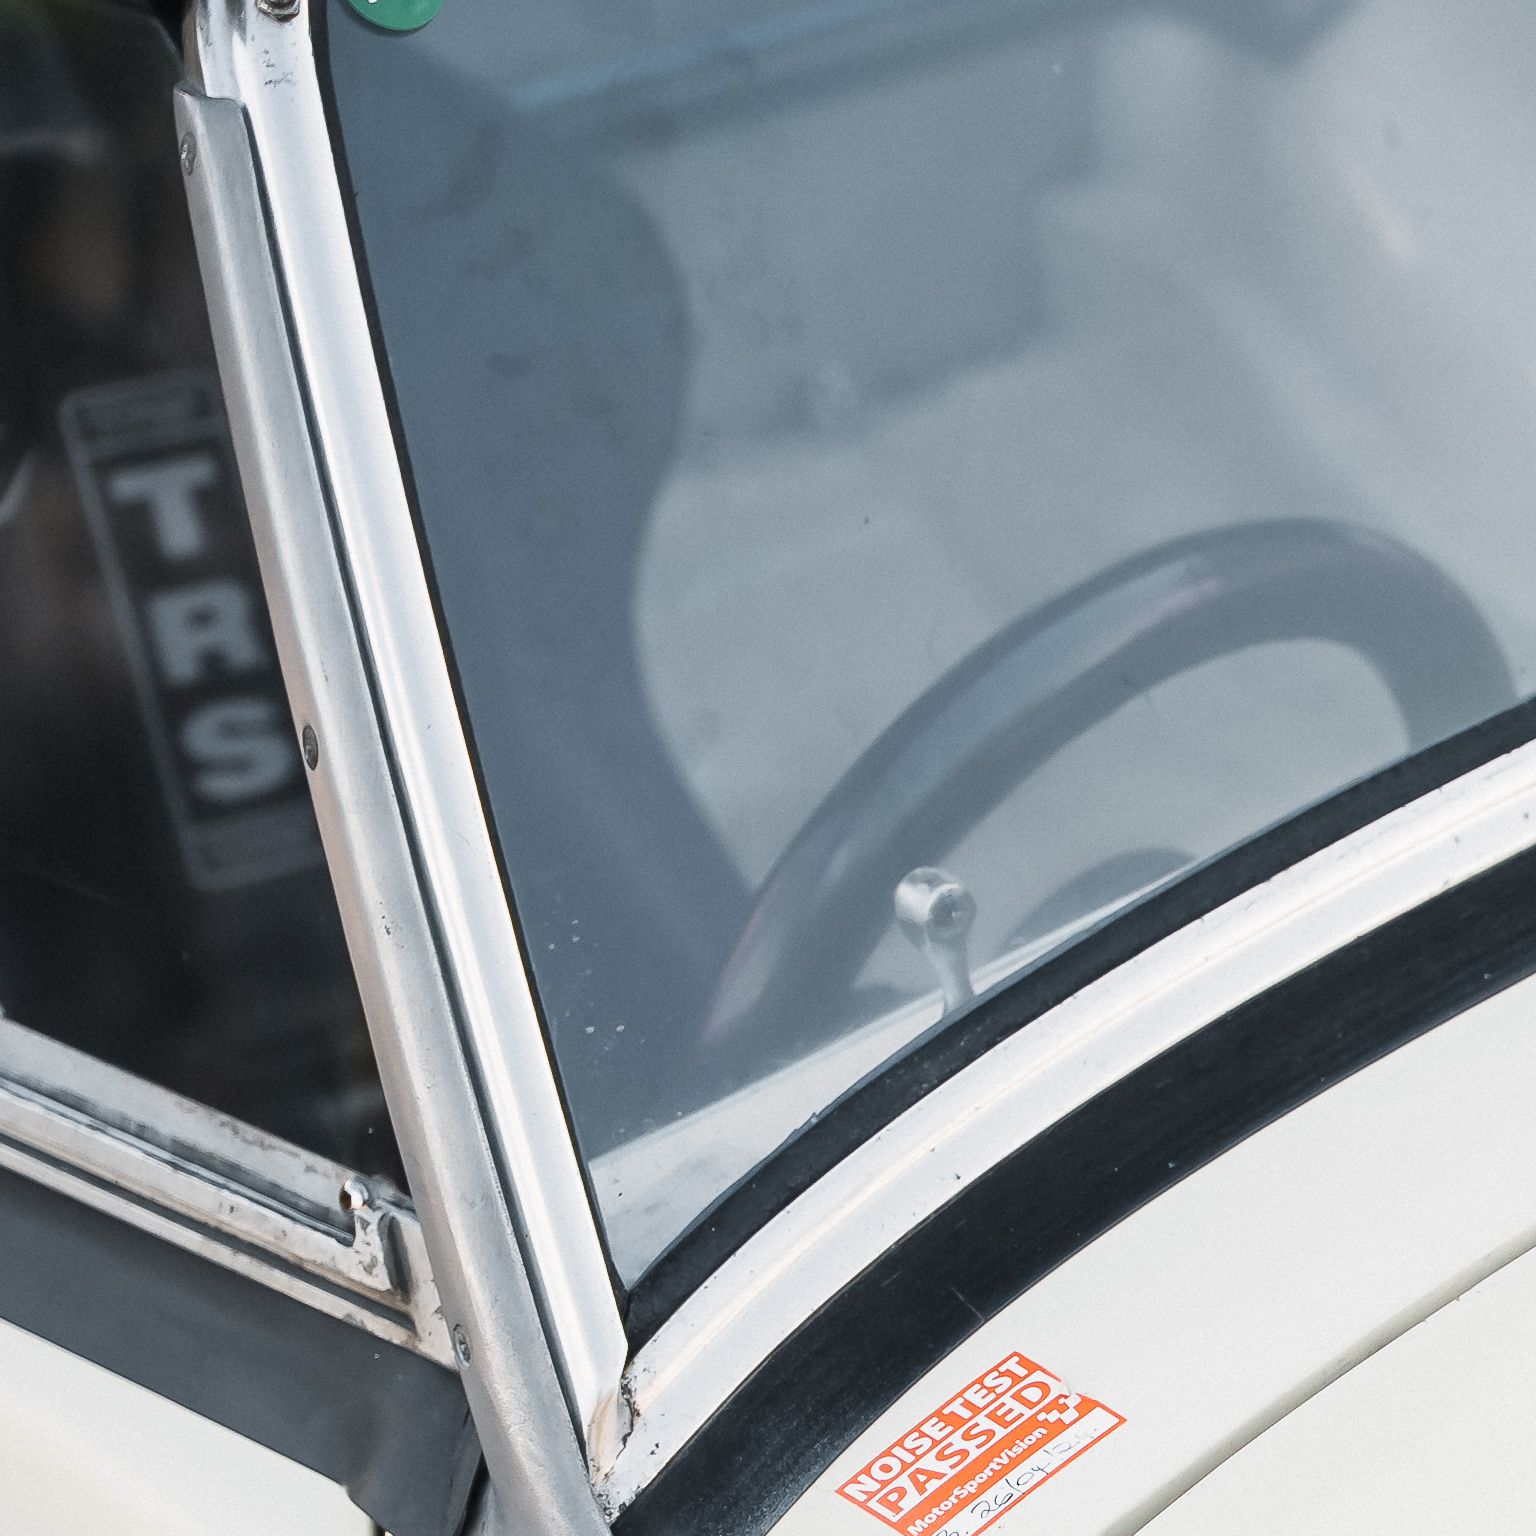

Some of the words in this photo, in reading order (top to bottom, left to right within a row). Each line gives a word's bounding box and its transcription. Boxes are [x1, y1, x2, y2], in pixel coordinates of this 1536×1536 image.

[109, 451, 296, 801] TRS
[842, 1416, 954, 1503] NOISE
[941, 1355, 1030, 1421] TEST
[875, 1380, 1051, 1516] PASSED
[906, 1426, 1048, 1536] MotorSportVision
